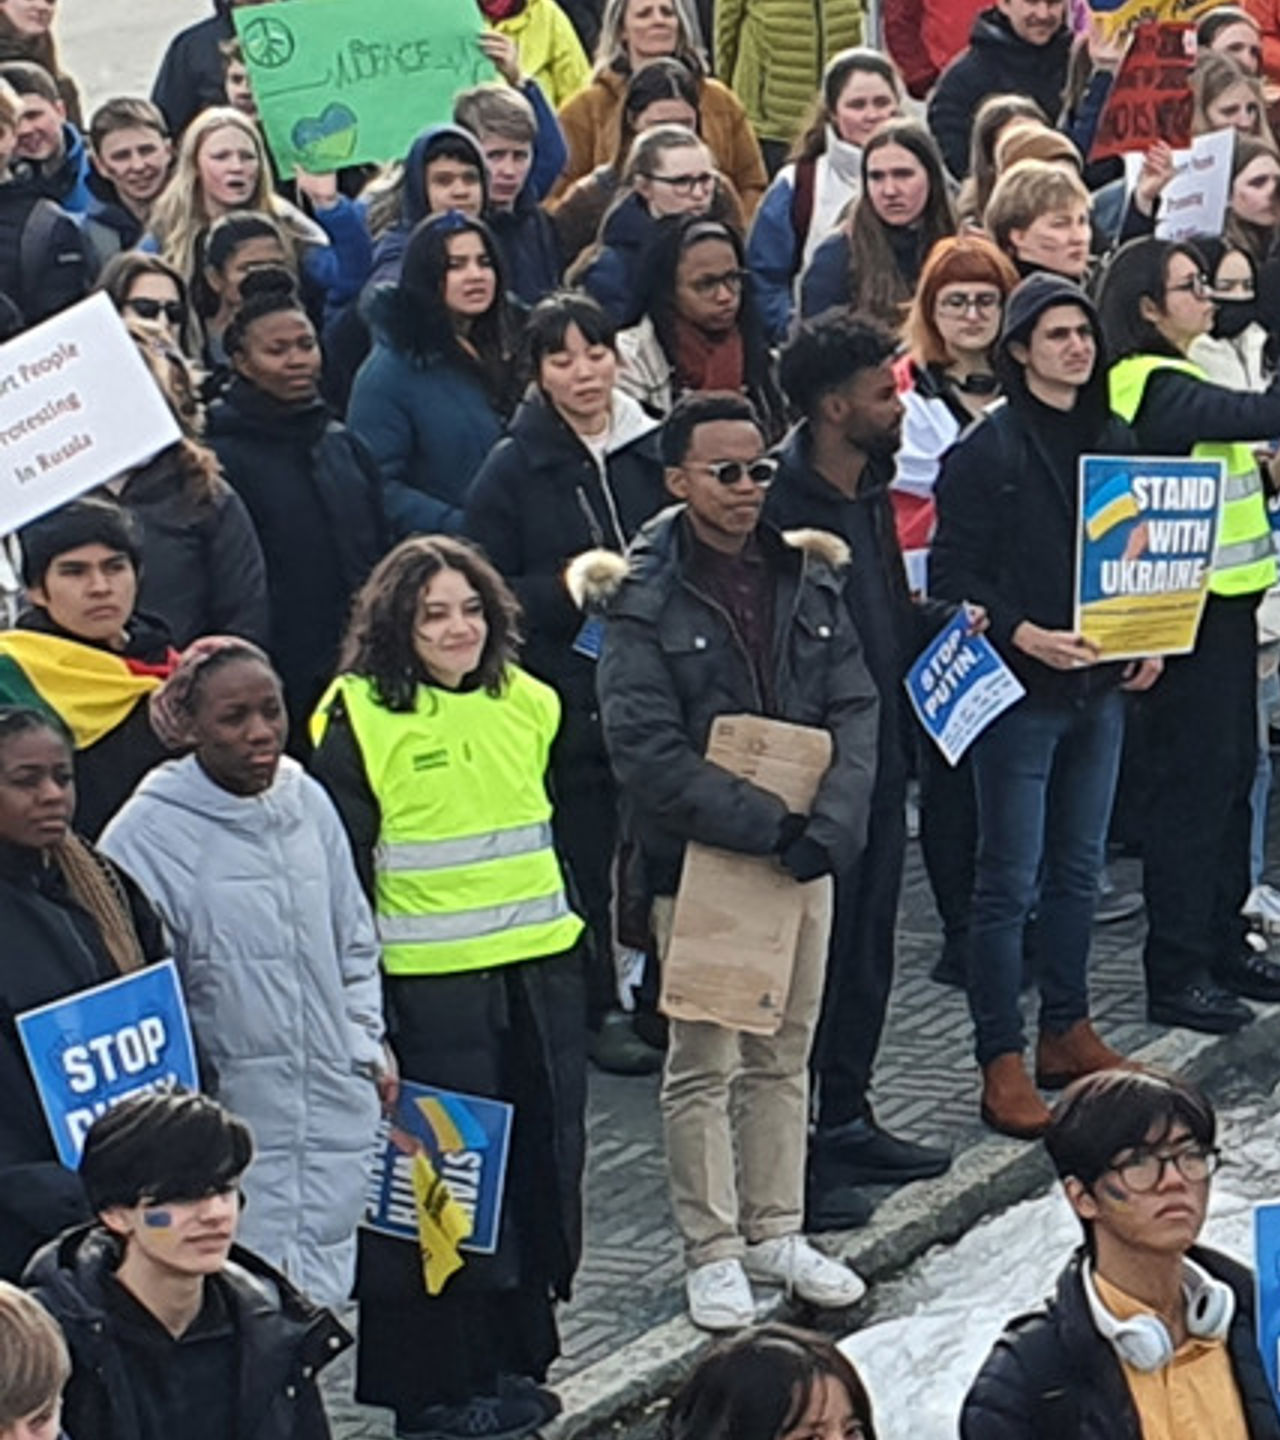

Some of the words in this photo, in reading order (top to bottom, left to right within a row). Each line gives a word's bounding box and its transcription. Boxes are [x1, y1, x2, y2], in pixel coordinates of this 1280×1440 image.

[18, 341, 80, 384] People
[0, 391, 83, 447] rotesting
[36, 433, 94, 473] Russia
[1132, 475, 1217, 511] STAND
[1148, 518, 1211, 554] WITH
[1100, 558, 1206, 595] UKRAINE
[920, 628, 962, 692] STOP
[62, 1015, 166, 1093] STOP
[443, 1151, 483, 1221] STA
